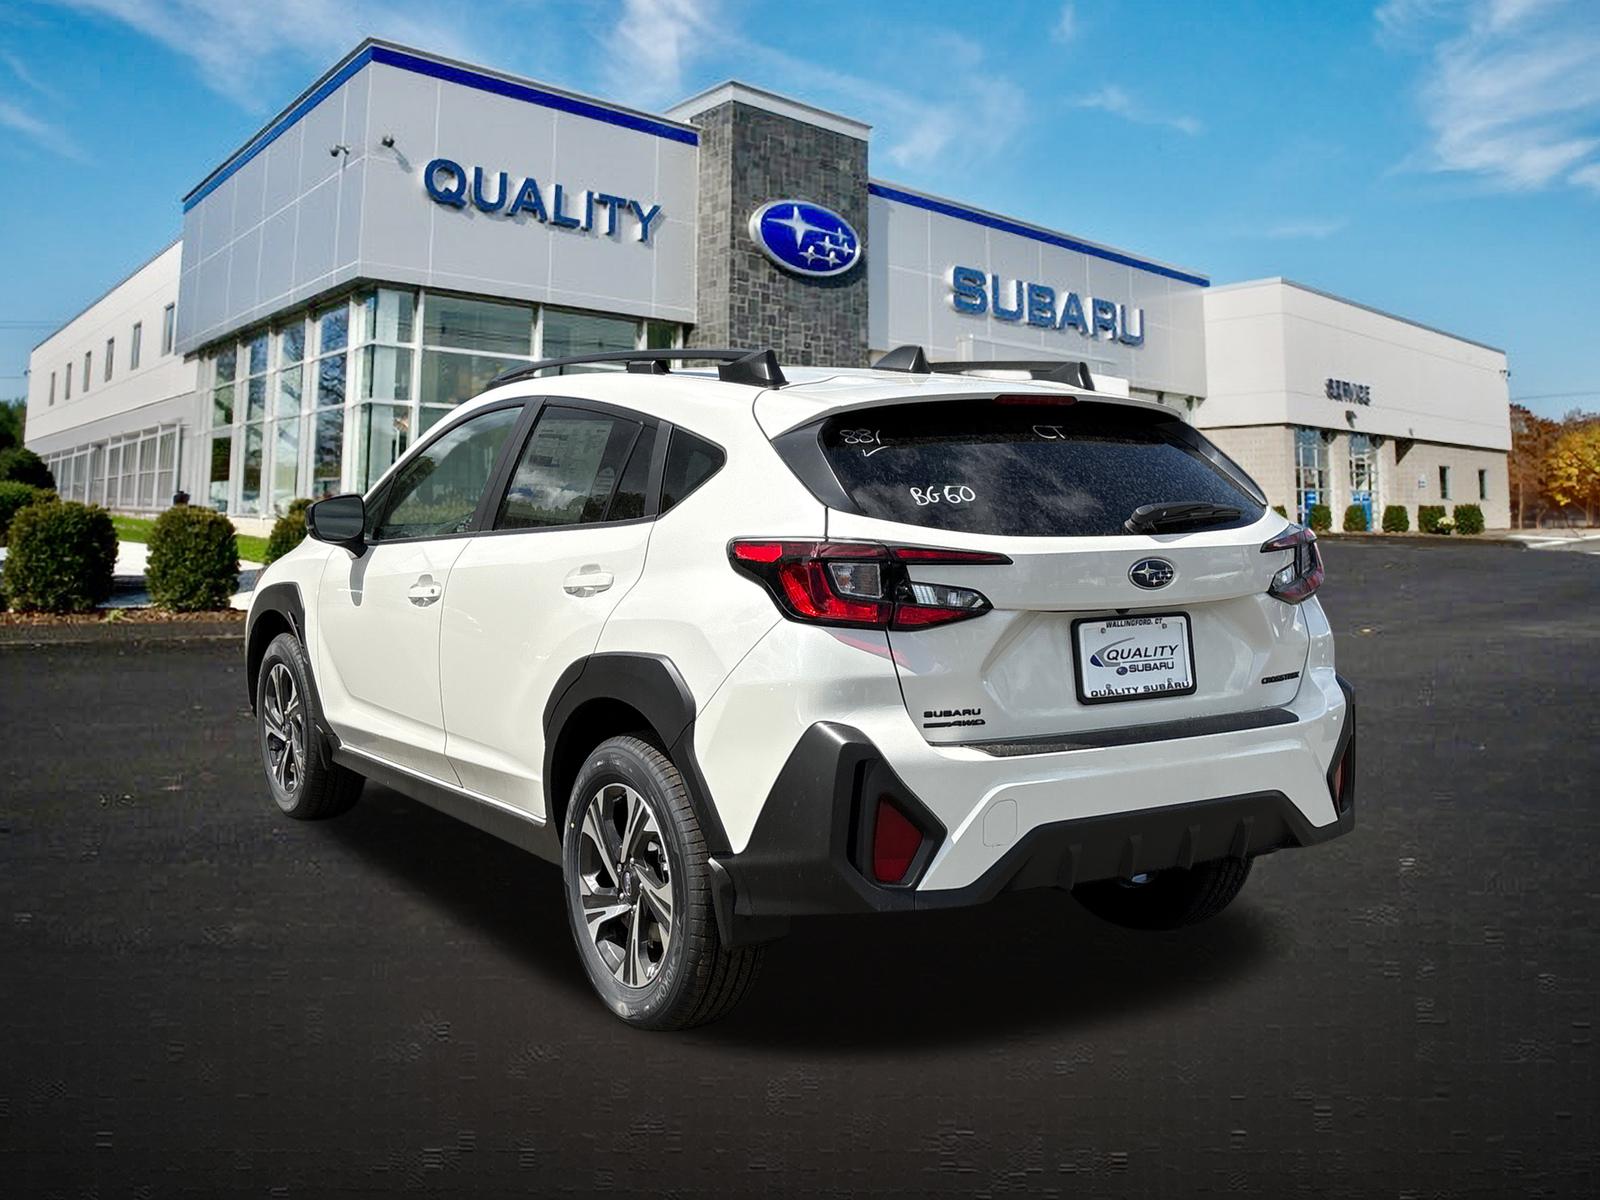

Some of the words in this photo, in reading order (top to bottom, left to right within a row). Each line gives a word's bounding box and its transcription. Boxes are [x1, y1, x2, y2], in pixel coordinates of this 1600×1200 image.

[424, 158, 661, 242] QUALITY
[950, 265, 1145, 347] SUBARU
[1106, 644, 1179, 661] QUALITY
[1128, 661, 1175, 673] SUBARU
[1090, 686, 1139, 698] QUALITY
[1142, 680, 1190, 693] SUBARU
[923, 708, 981, 718] SUBARU
